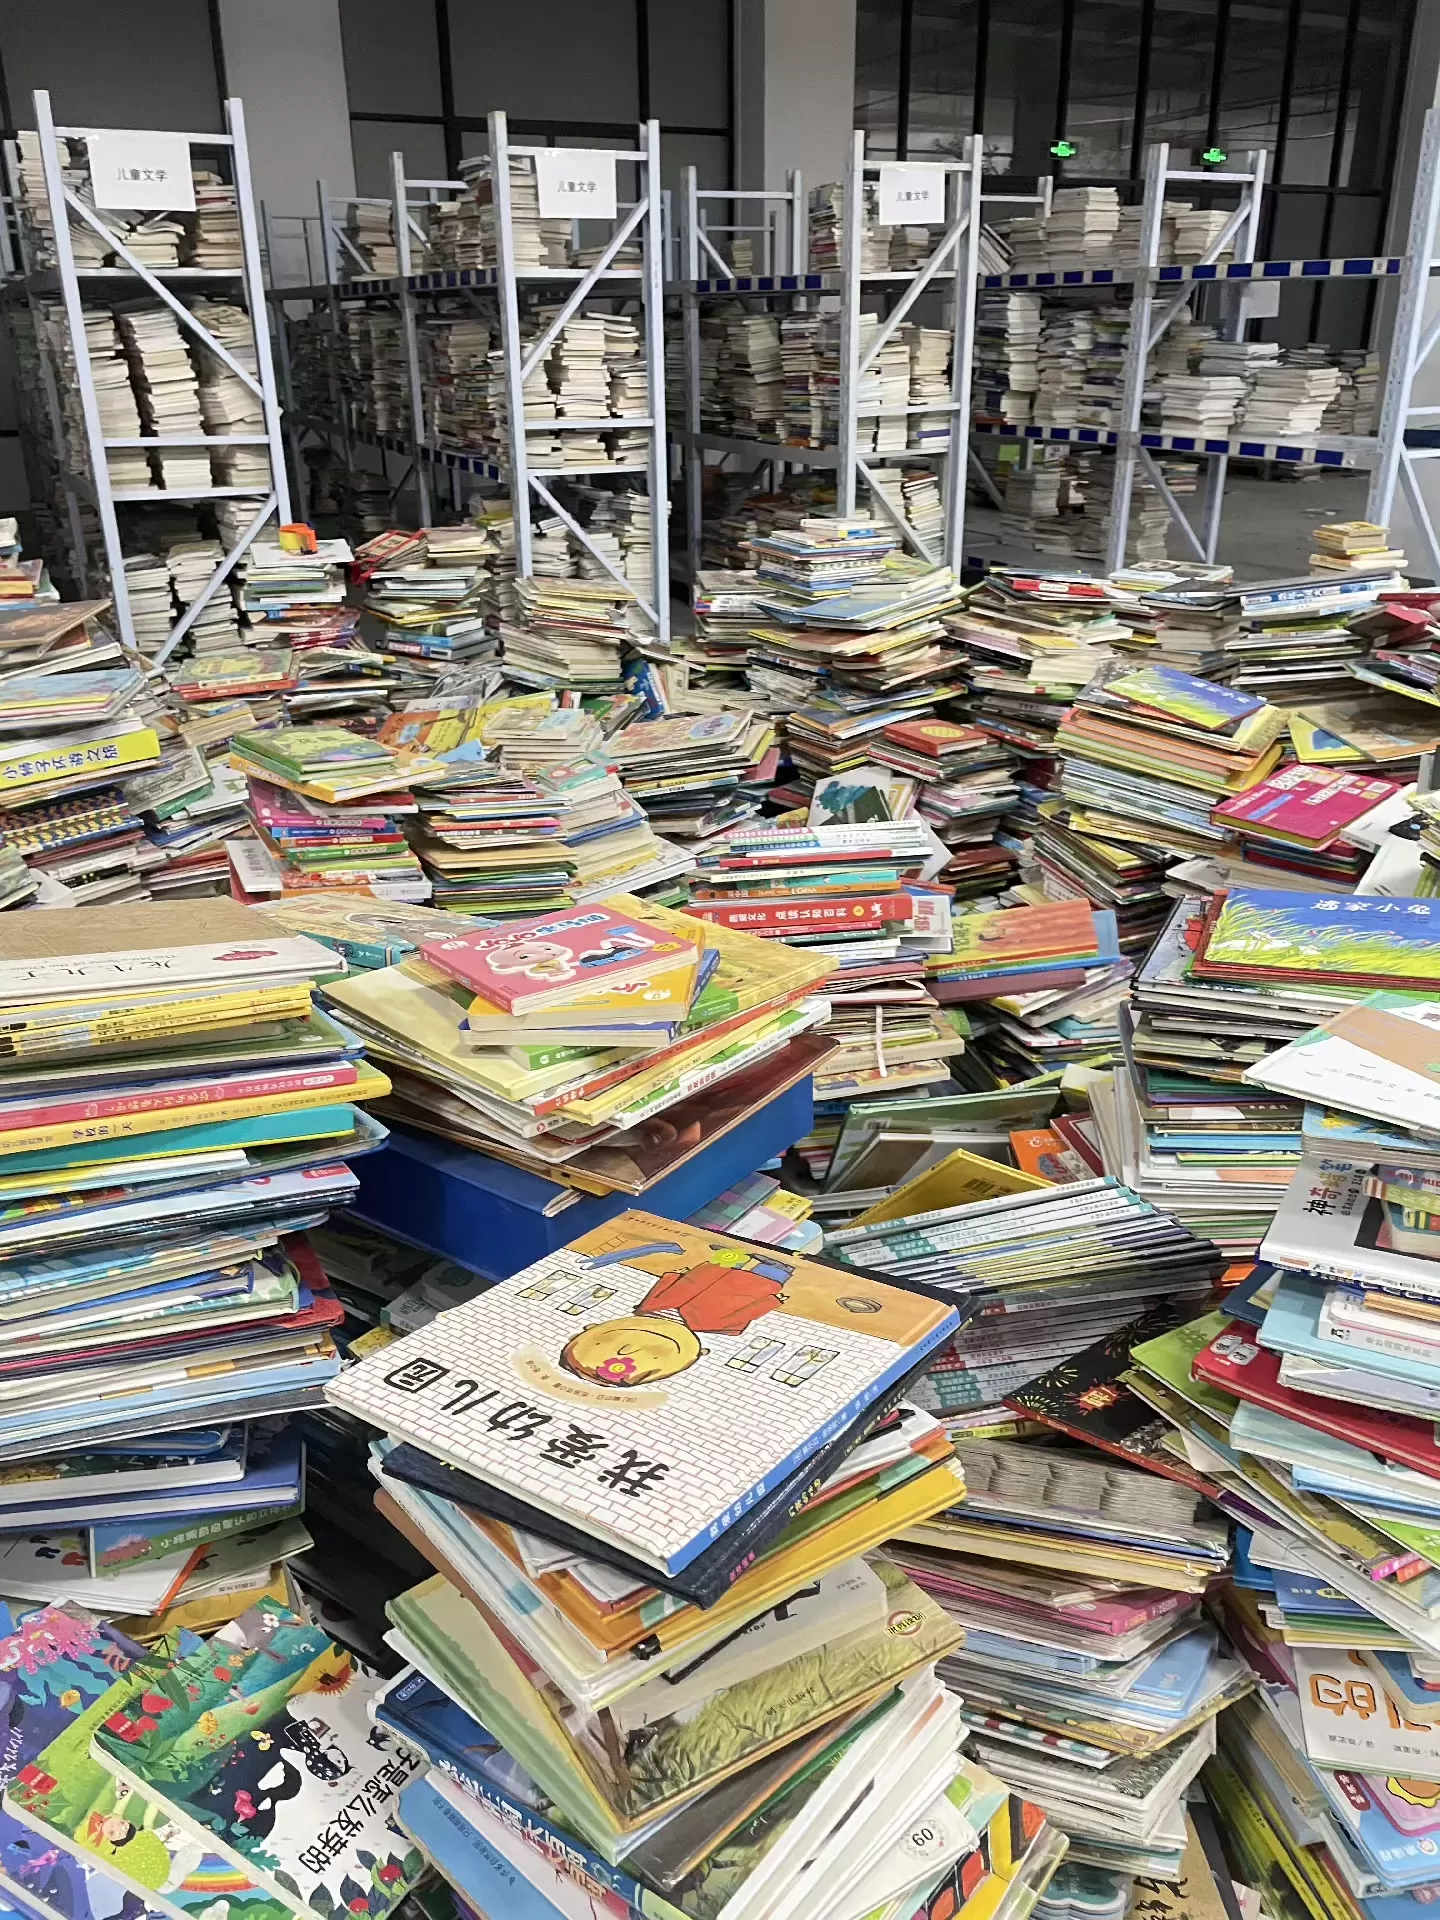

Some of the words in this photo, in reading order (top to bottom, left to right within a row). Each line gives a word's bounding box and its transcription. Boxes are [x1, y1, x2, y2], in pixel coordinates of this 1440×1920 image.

[116, 167, 169, 182] 儿童文学
[557, 180, 598, 194] 儿童文学
[896, 190, 930, 202] 儿童文学
[1310, 898, 1431, 914] 逃家小兔
[71, 1121, 134, 1141] 学校的一天
[381, 1355, 676, 1500] 我爱幼儿园
[707, 1480, 766, 1540] 我爱幼儿园
[298, 1746, 421, 1875] 子是怎么发芽的
[911, 1828, 934, 1847] 60
